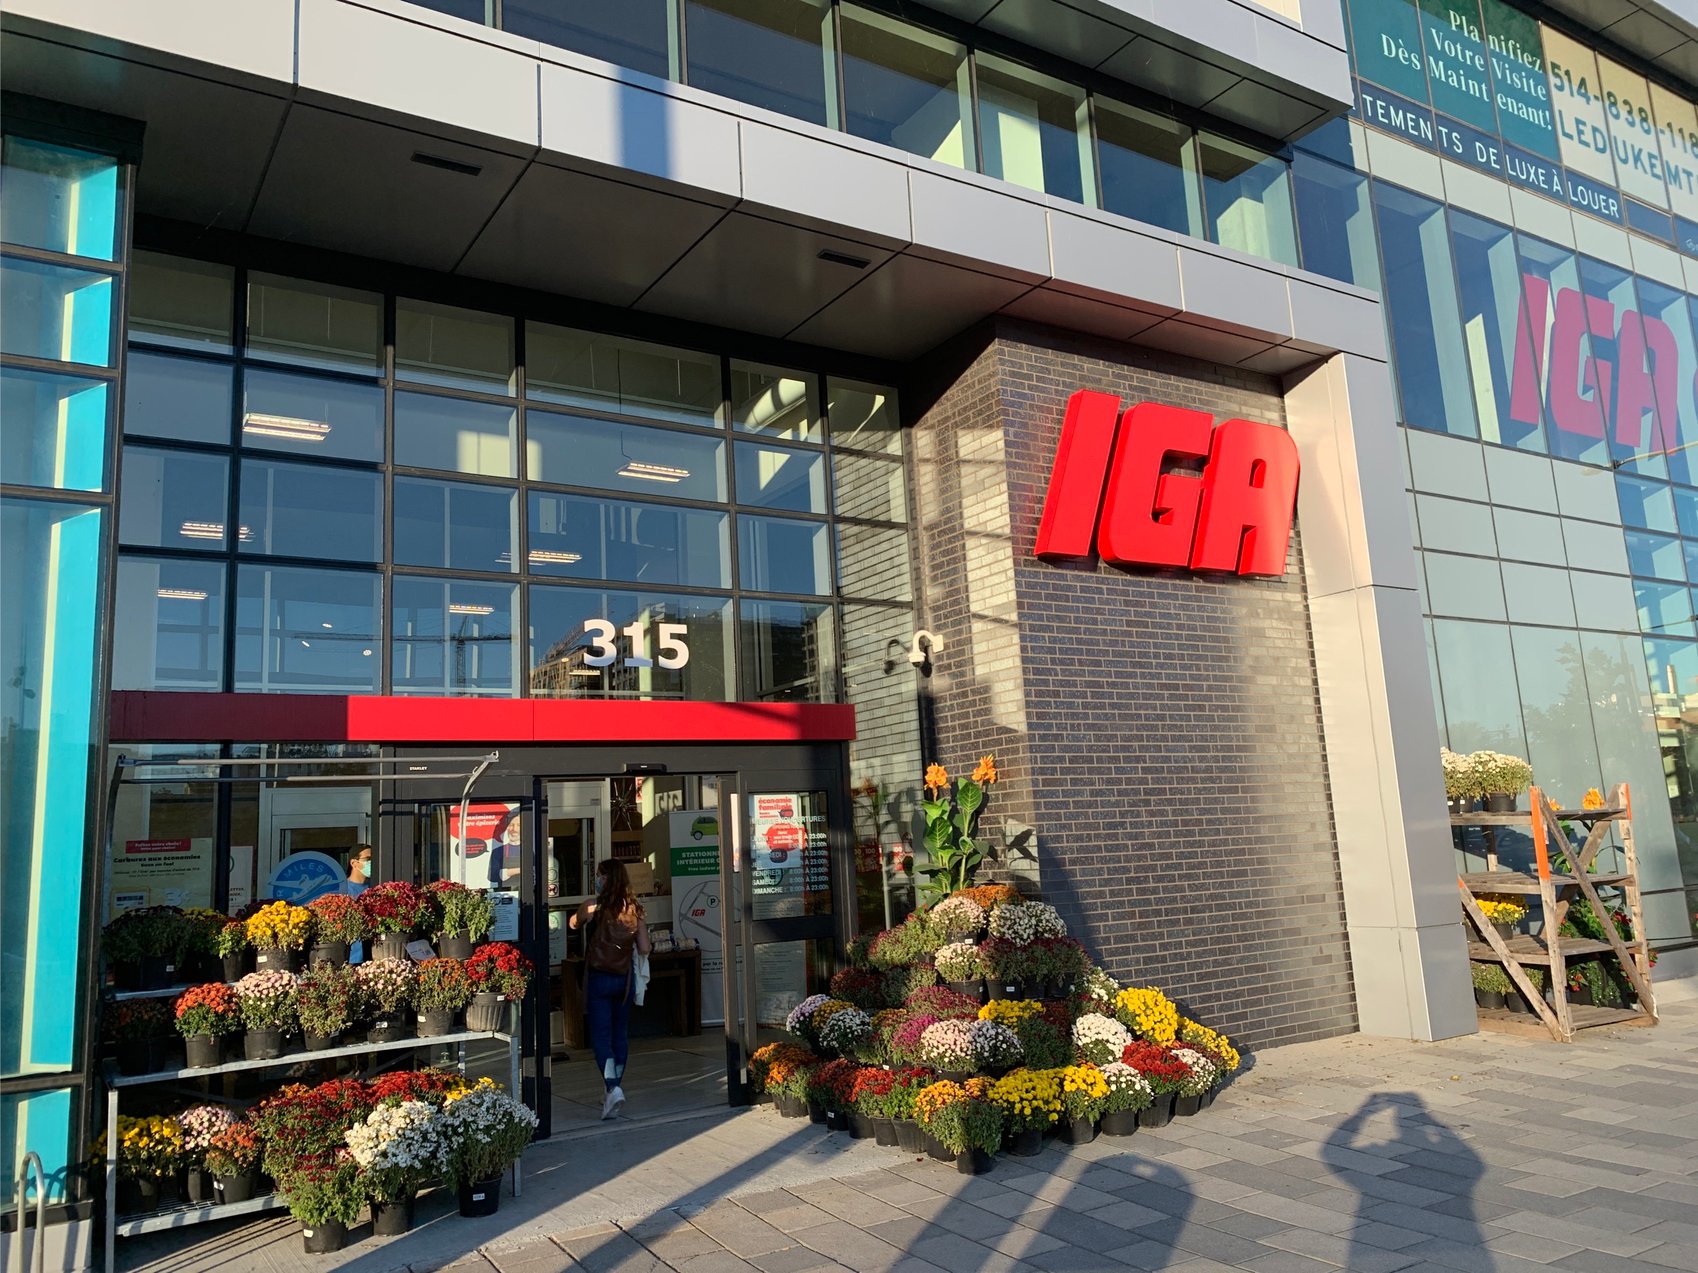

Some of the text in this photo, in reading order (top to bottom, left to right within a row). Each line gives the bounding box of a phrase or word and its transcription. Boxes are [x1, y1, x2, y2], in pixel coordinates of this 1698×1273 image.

[1380, 32, 1421, 71] Dès
[1430, 27, 1548, 101] Votre Visite
[1353, 94, 1620, 219] TEMENTS DE LUXE À LOUER
[1558, 109, 1698, 196] LEDUKEMT
[1510, 272, 1679, 456] IGA
[1034, 388, 1300, 577] IGA
[583, 618, 690, 670] 315
[283, 862, 324, 878] MILES
[691, 909, 705, 917] IGA
